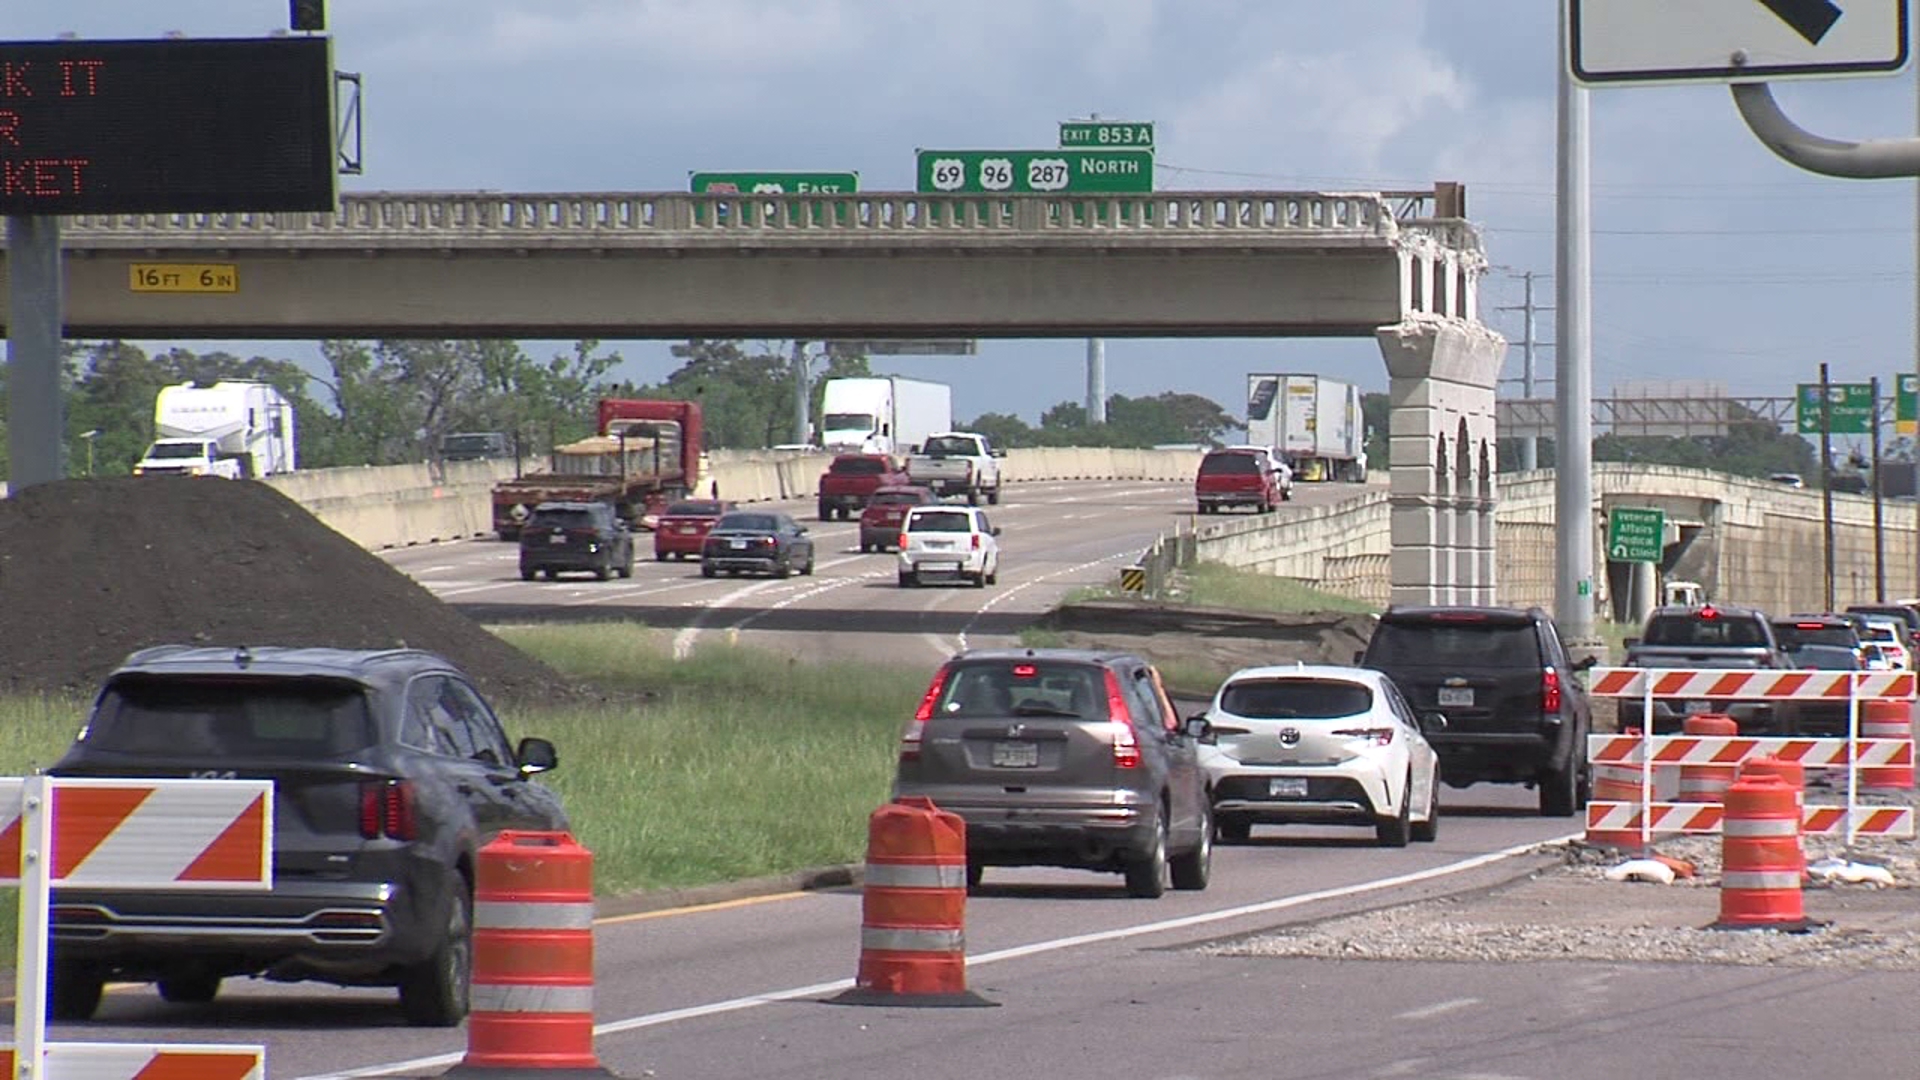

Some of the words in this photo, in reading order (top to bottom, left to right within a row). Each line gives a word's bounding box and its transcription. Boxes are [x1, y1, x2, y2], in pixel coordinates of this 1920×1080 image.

[59, 60, 104, 96] IT
[0, 110, 20, 146] R
[1062, 129, 1092, 141] EXIT
[1098, 126, 1134, 144] 853
[1138, 127, 1151, 143] A
[936, 165, 961, 184] 69
[983, 165, 1009, 184] 96
[1031, 165, 1066, 184] 287
[1081, 157, 1139, 174] NORTH
[137, 268, 160, 287] 16
[163, 273, 181, 287] FT
[199, 269, 214, 287] 6
[217, 274, 232, 287] IN
